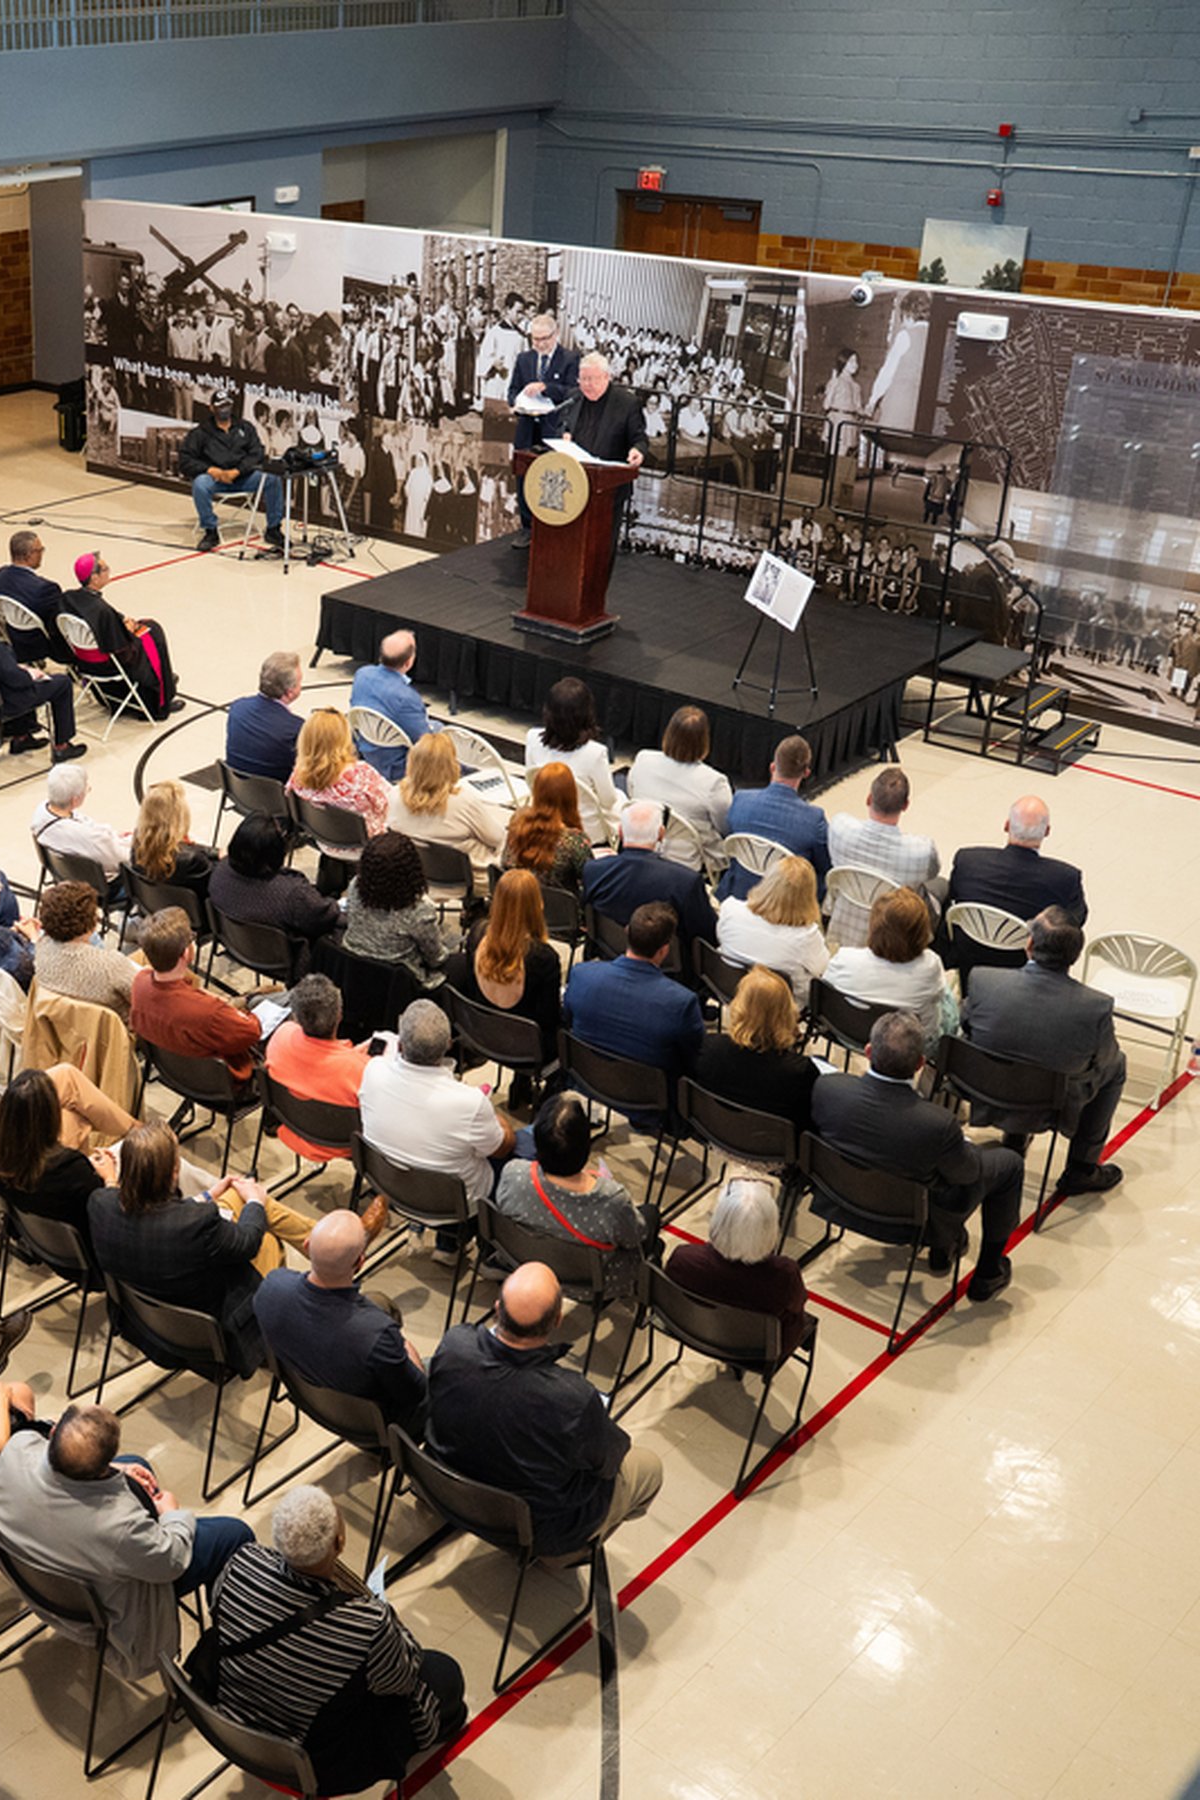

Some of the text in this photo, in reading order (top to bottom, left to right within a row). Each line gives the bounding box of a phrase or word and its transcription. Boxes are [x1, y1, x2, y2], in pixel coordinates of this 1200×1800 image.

[113, 357, 142, 373] What
[143, 362, 163, 378] has
[196, 374, 225, 390] what
[243, 382, 266, 399] and
[268, 386, 298, 405] what
[300, 392, 322, 408] will
